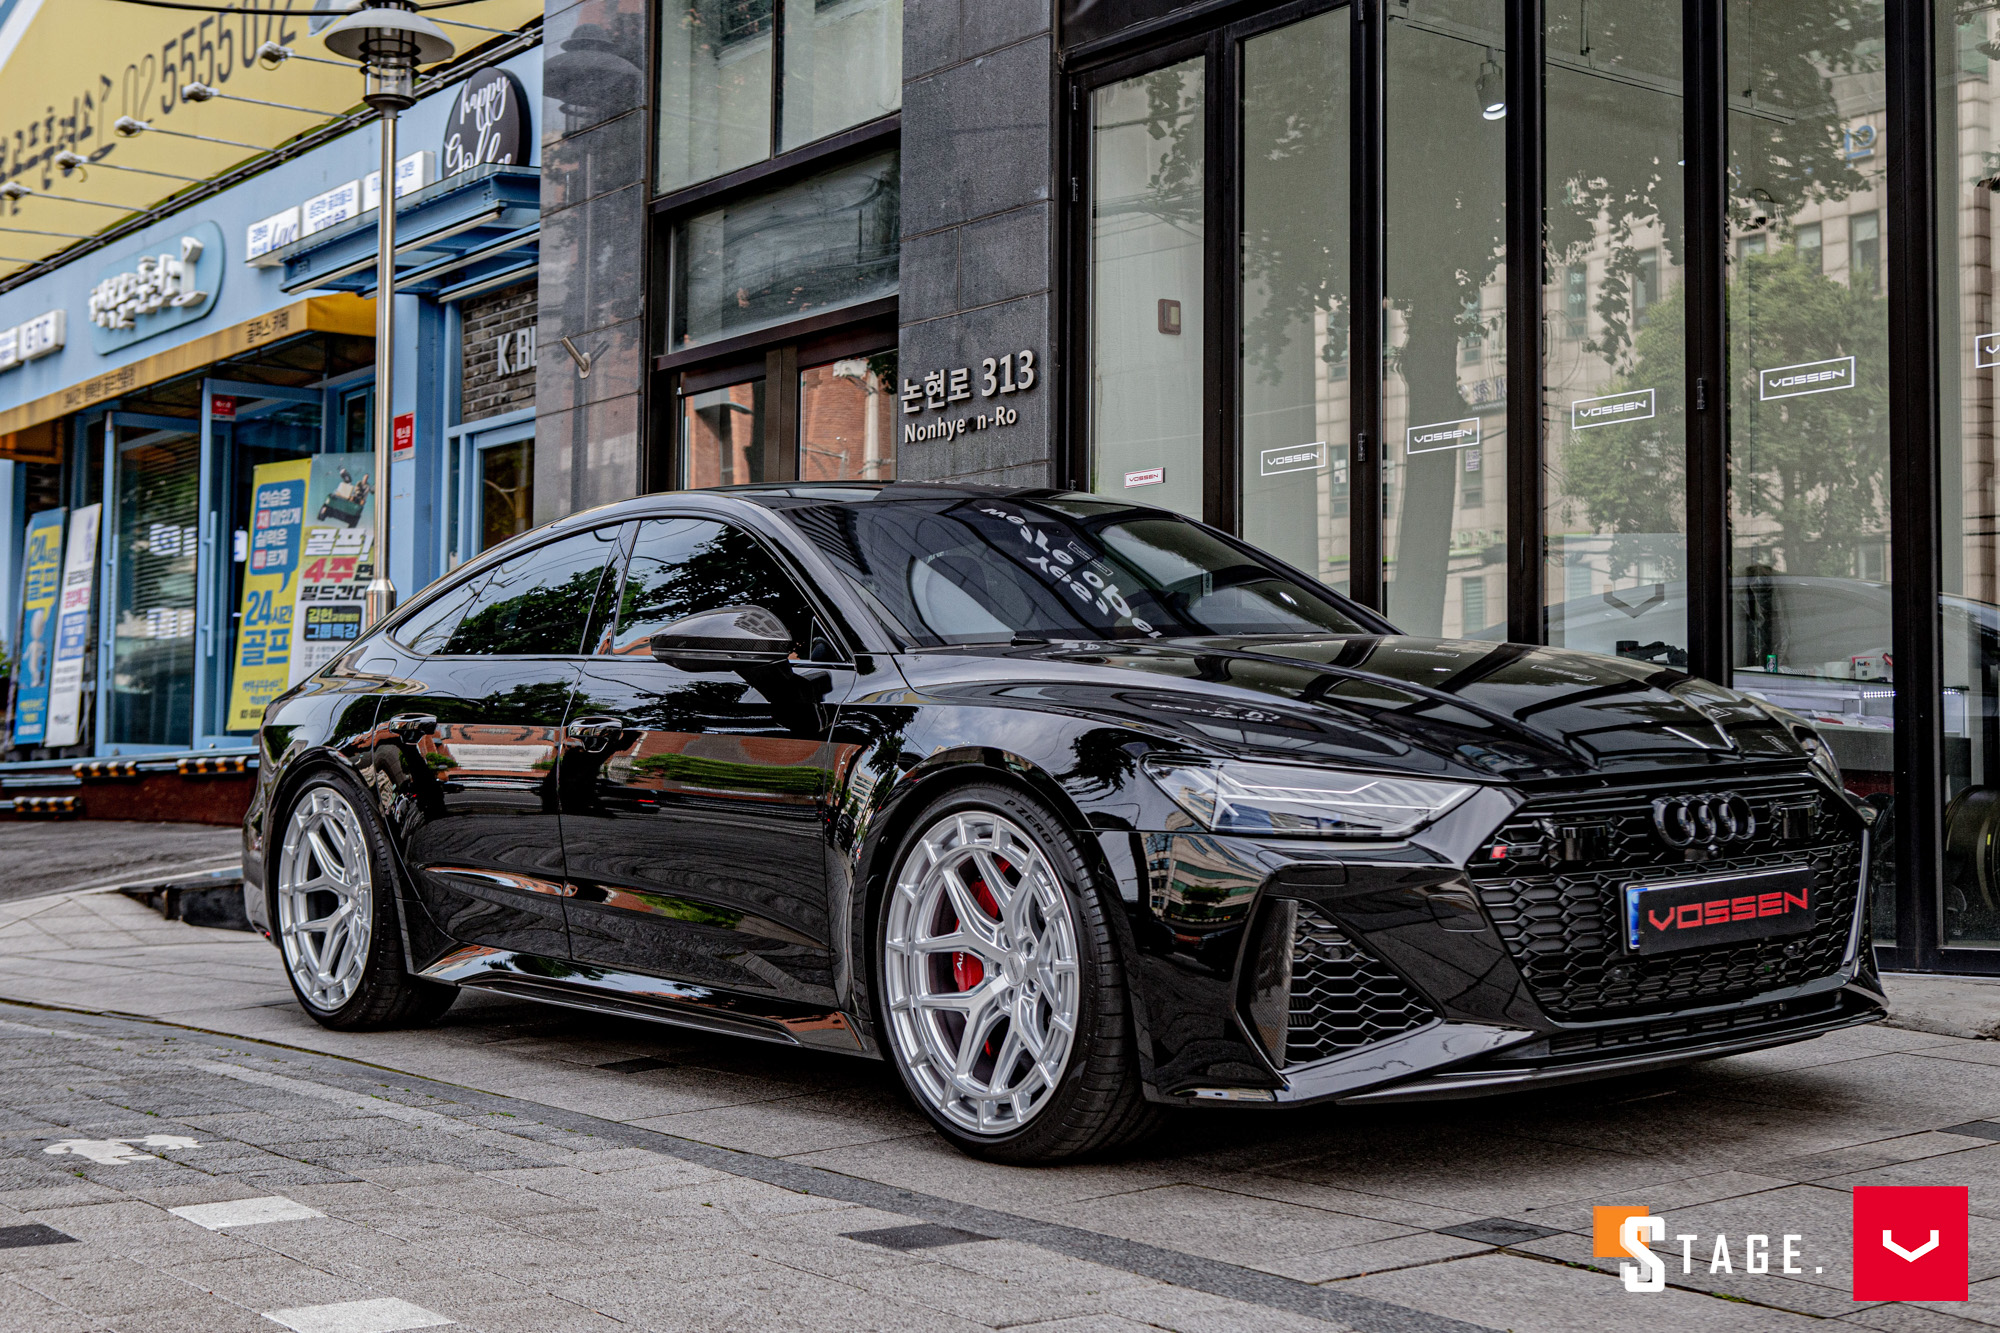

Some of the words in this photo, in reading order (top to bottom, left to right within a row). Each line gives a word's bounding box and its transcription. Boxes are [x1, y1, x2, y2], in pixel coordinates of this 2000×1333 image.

[460, 77, 511, 132] happy
[900, 367, 971, 414] 논현로
[981, 349, 1035, 397] 313
[1769, 368, 1845, 388] VOSSEN
[1579, 399, 1646, 418] VOSSEN
[1413, 427, 1473, 444] VOSSEN
[1267, 451, 1320, 466] VOSSEN
[1128, 473, 1159, 482] VOSSEN
[258, 488, 291, 508] 연습은
[256, 507, 301, 528] 재미있게
[254, 528, 288, 548] 실력은
[304, 528, 374, 562] 골프!
[244, 589, 293, 627] 24시간
[305, 623, 359, 639] 그룹특강
[241, 628, 290, 667] 골프
[1015, 806, 1054, 844] ZERO
[1648, 888, 1808, 931] VOSSEN
